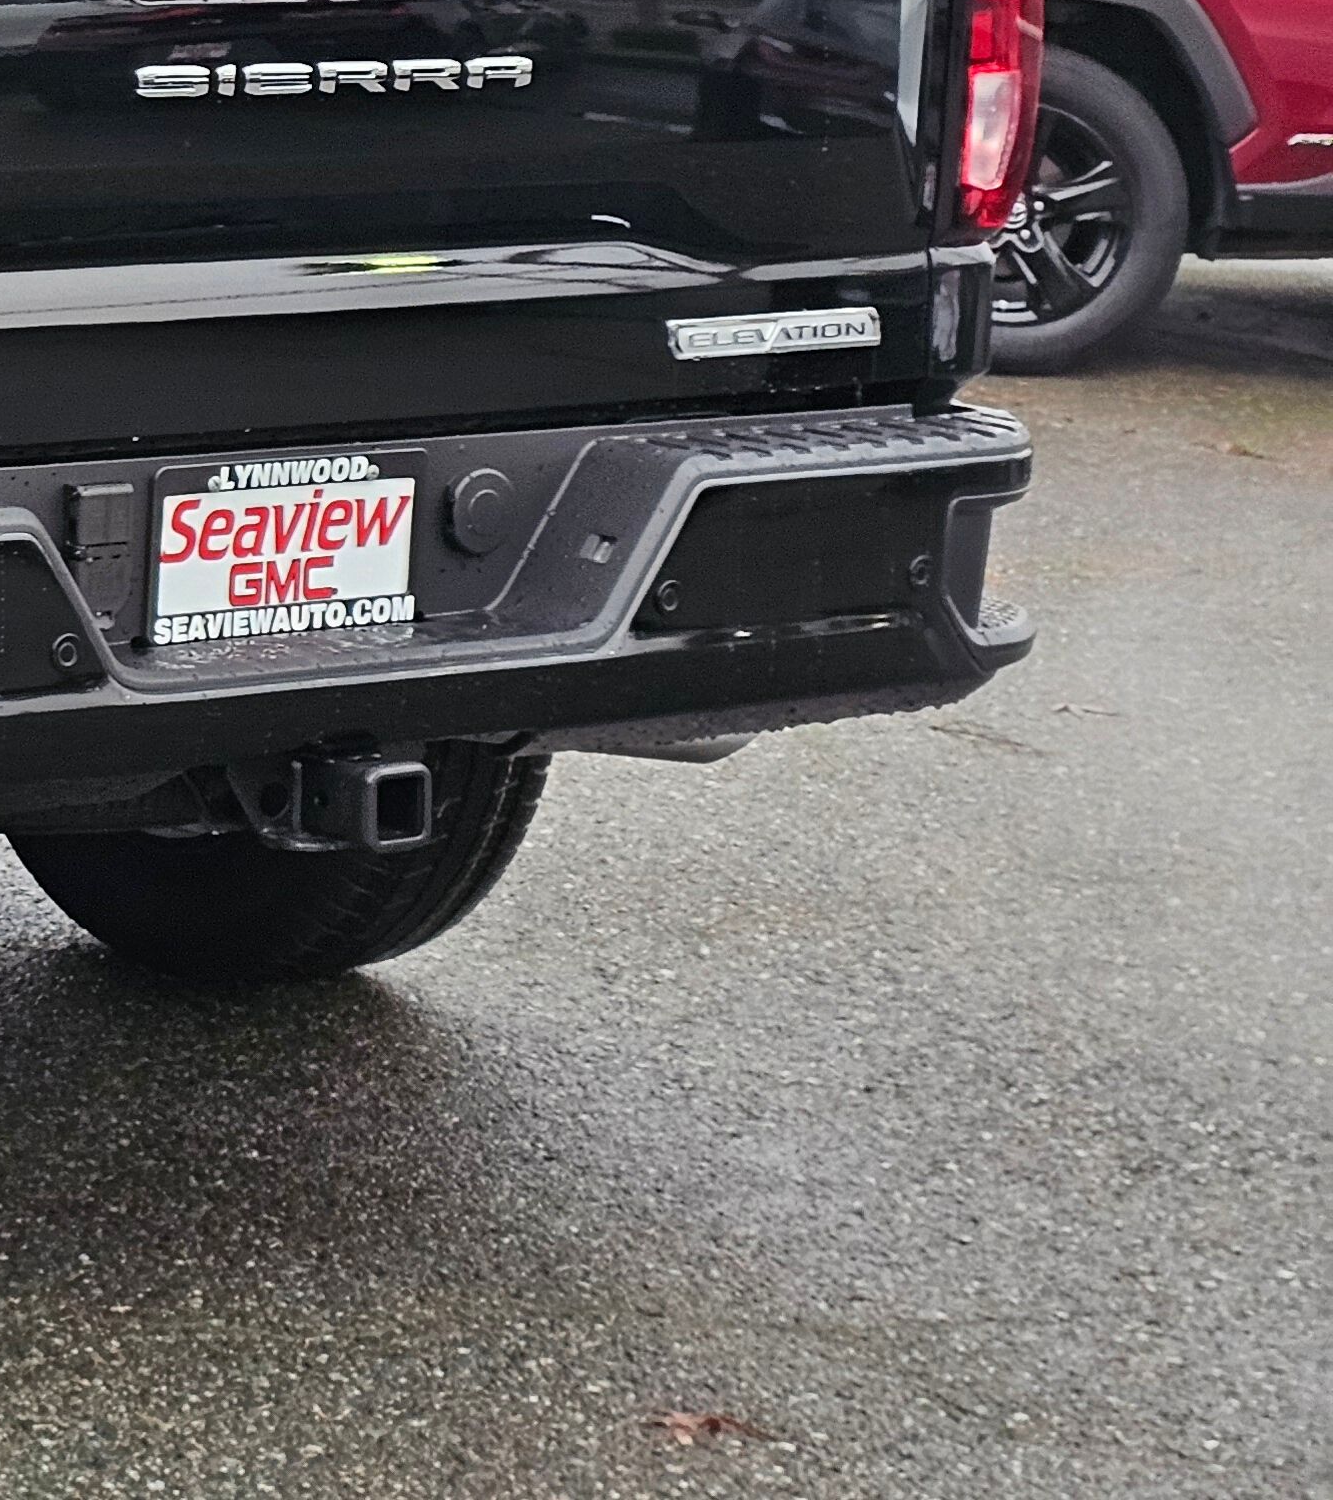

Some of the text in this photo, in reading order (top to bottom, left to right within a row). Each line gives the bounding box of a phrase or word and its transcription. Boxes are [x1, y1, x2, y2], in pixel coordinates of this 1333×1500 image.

[134, 55, 534, 99] SIERRA
[688, 321, 867, 348] ELEVATION
[219, 455, 371, 491] LYNNWOOD
[159, 488, 411, 564] Seaview
[229, 555, 337, 607] GMC
[153, 595, 416, 646] SEAVIEWAUTO.COM
